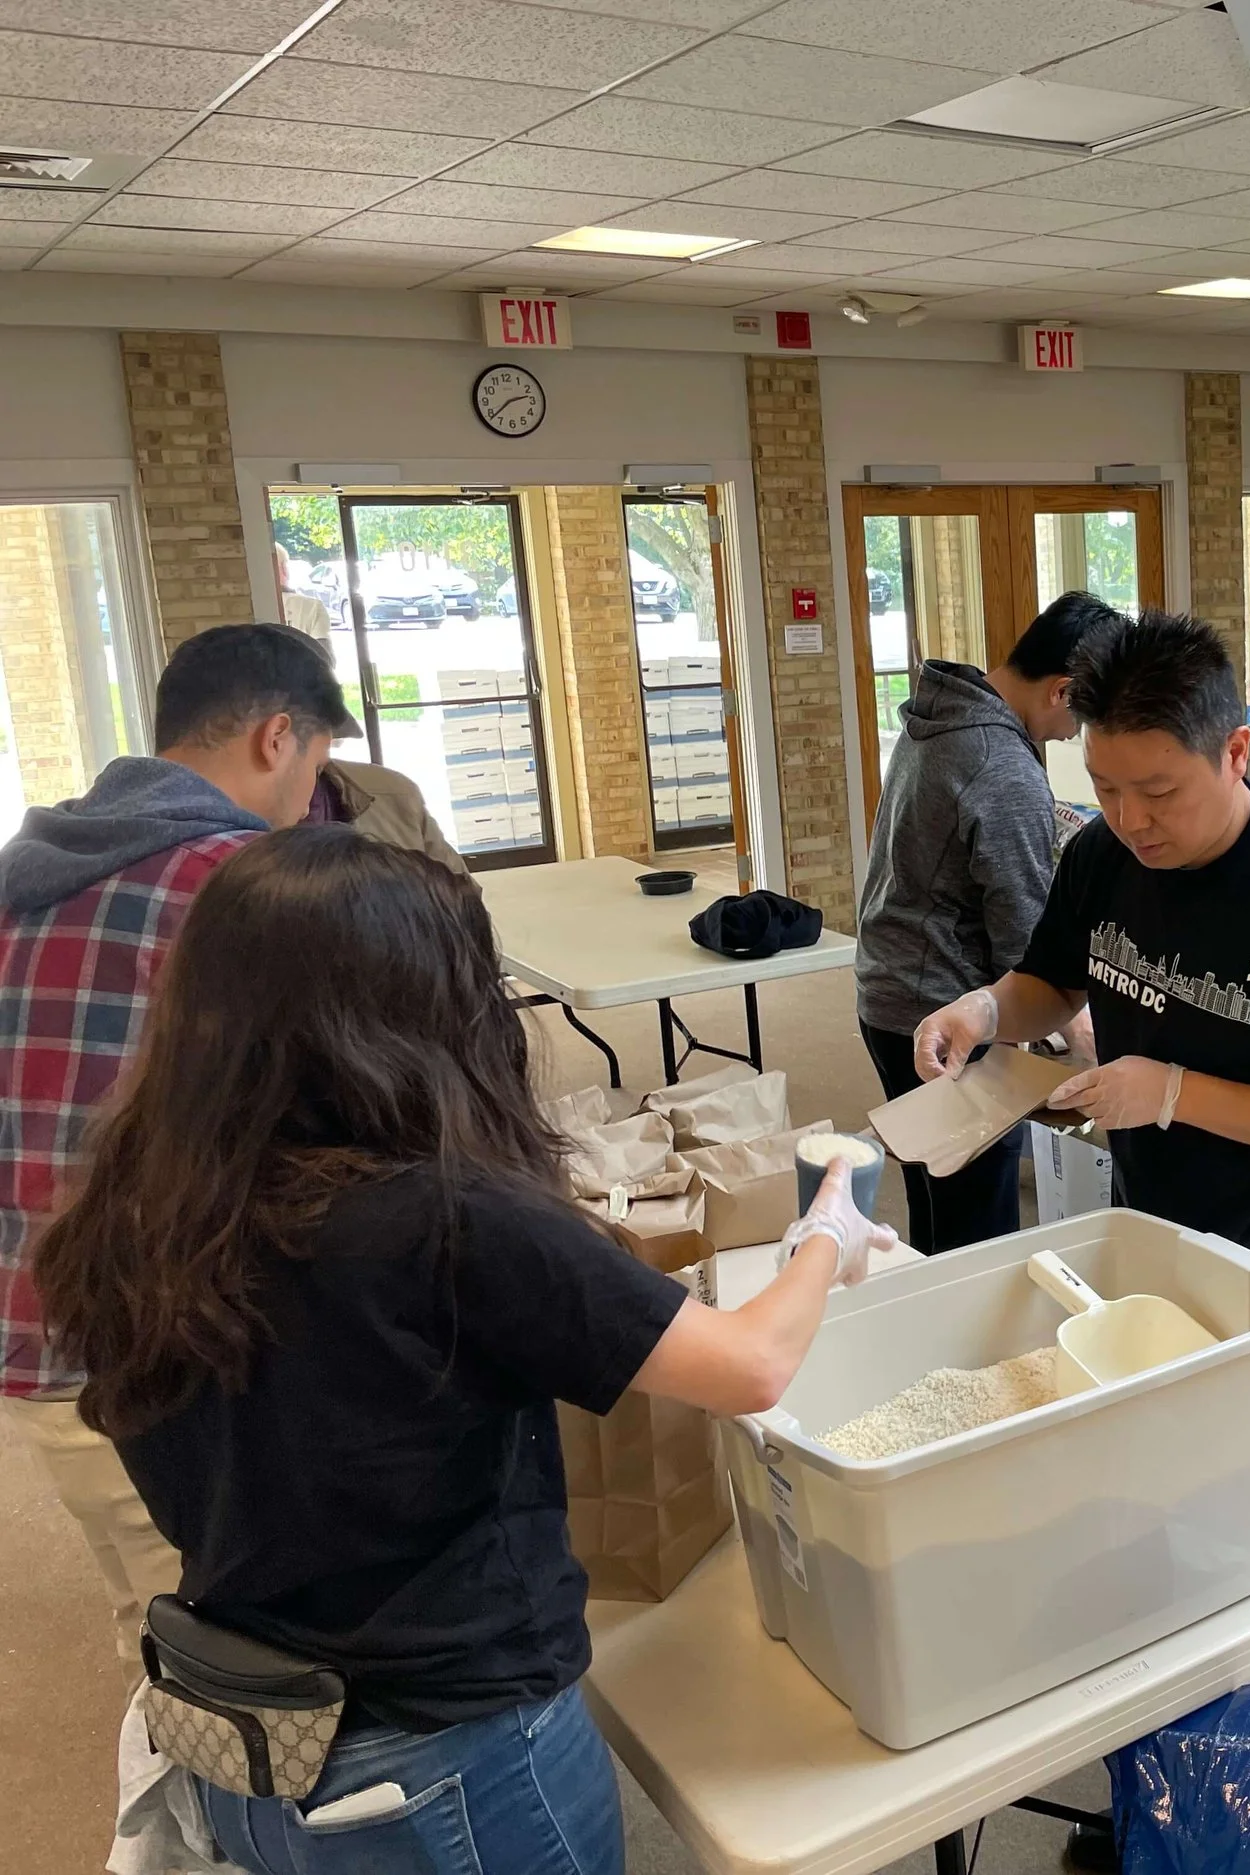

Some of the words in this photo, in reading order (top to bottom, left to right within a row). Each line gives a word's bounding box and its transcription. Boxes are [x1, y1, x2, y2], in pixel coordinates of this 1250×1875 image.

[500, 299, 557, 345] EXIT
[1036, 331, 1074, 368] EXIT
[491, 377, 499, 386] 11
[501, 373, 512, 383] 12
[515, 377, 521, 386] 1
[484, 386, 495, 396] 10
[524, 385, 531, 394] 2
[482, 397, 489, 406] 9
[529, 396, 536, 405] 3
[487, 409, 494, 418] 8
[527, 408, 534, 416] 4
[498, 417, 504, 425] 7
[509, 419, 516, 429] 6
[520, 417, 527, 426] 5
[1088, 957, 1139, 999] METRO
[1140, 986, 1166, 1014] DC
